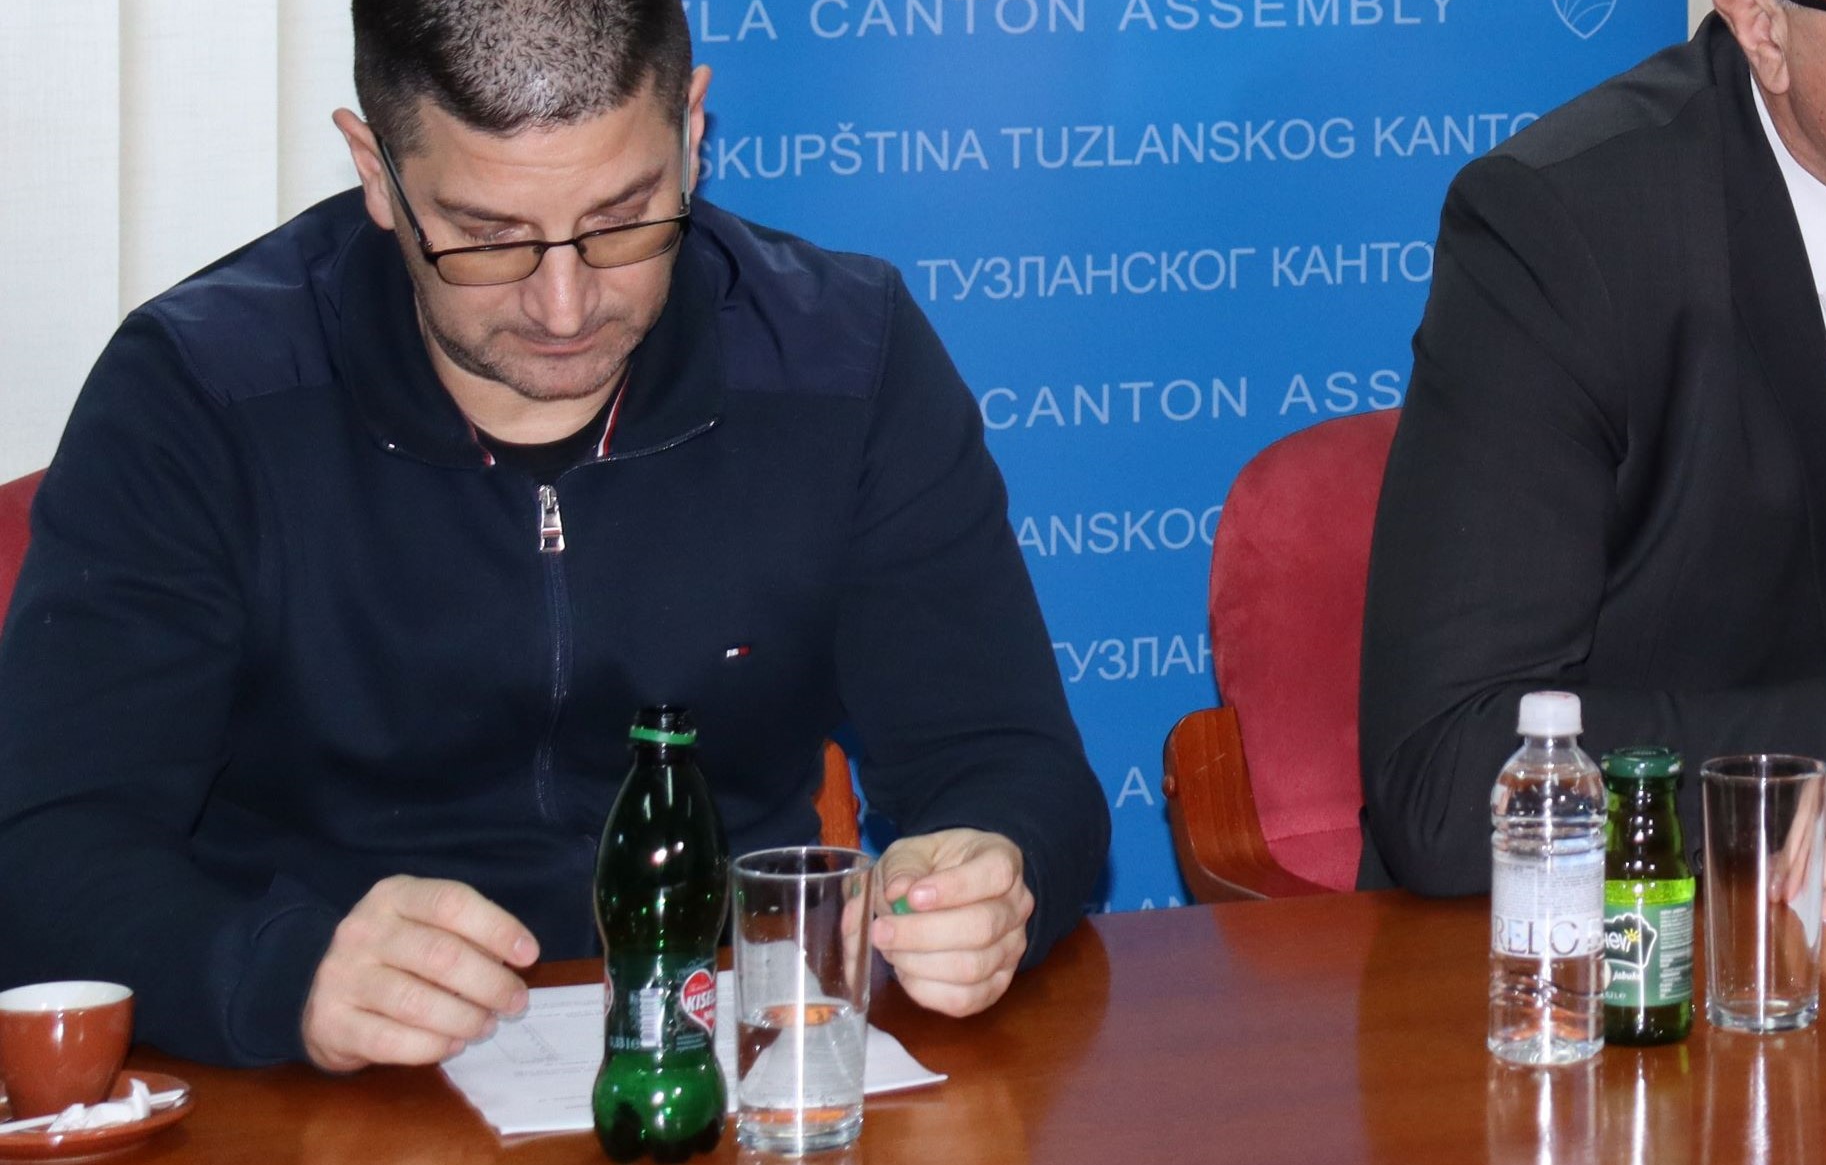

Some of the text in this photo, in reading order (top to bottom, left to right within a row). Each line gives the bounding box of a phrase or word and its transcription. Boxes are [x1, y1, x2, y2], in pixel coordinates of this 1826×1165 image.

[1001, 117, 1356, 170] TUZLANSKOG
[917, 247, 1257, 302] ТУЗЛАНСКОГ
[980, 377, 1248, 430] CANTON
[1052, 633, 1212, 682] УЗЛА
